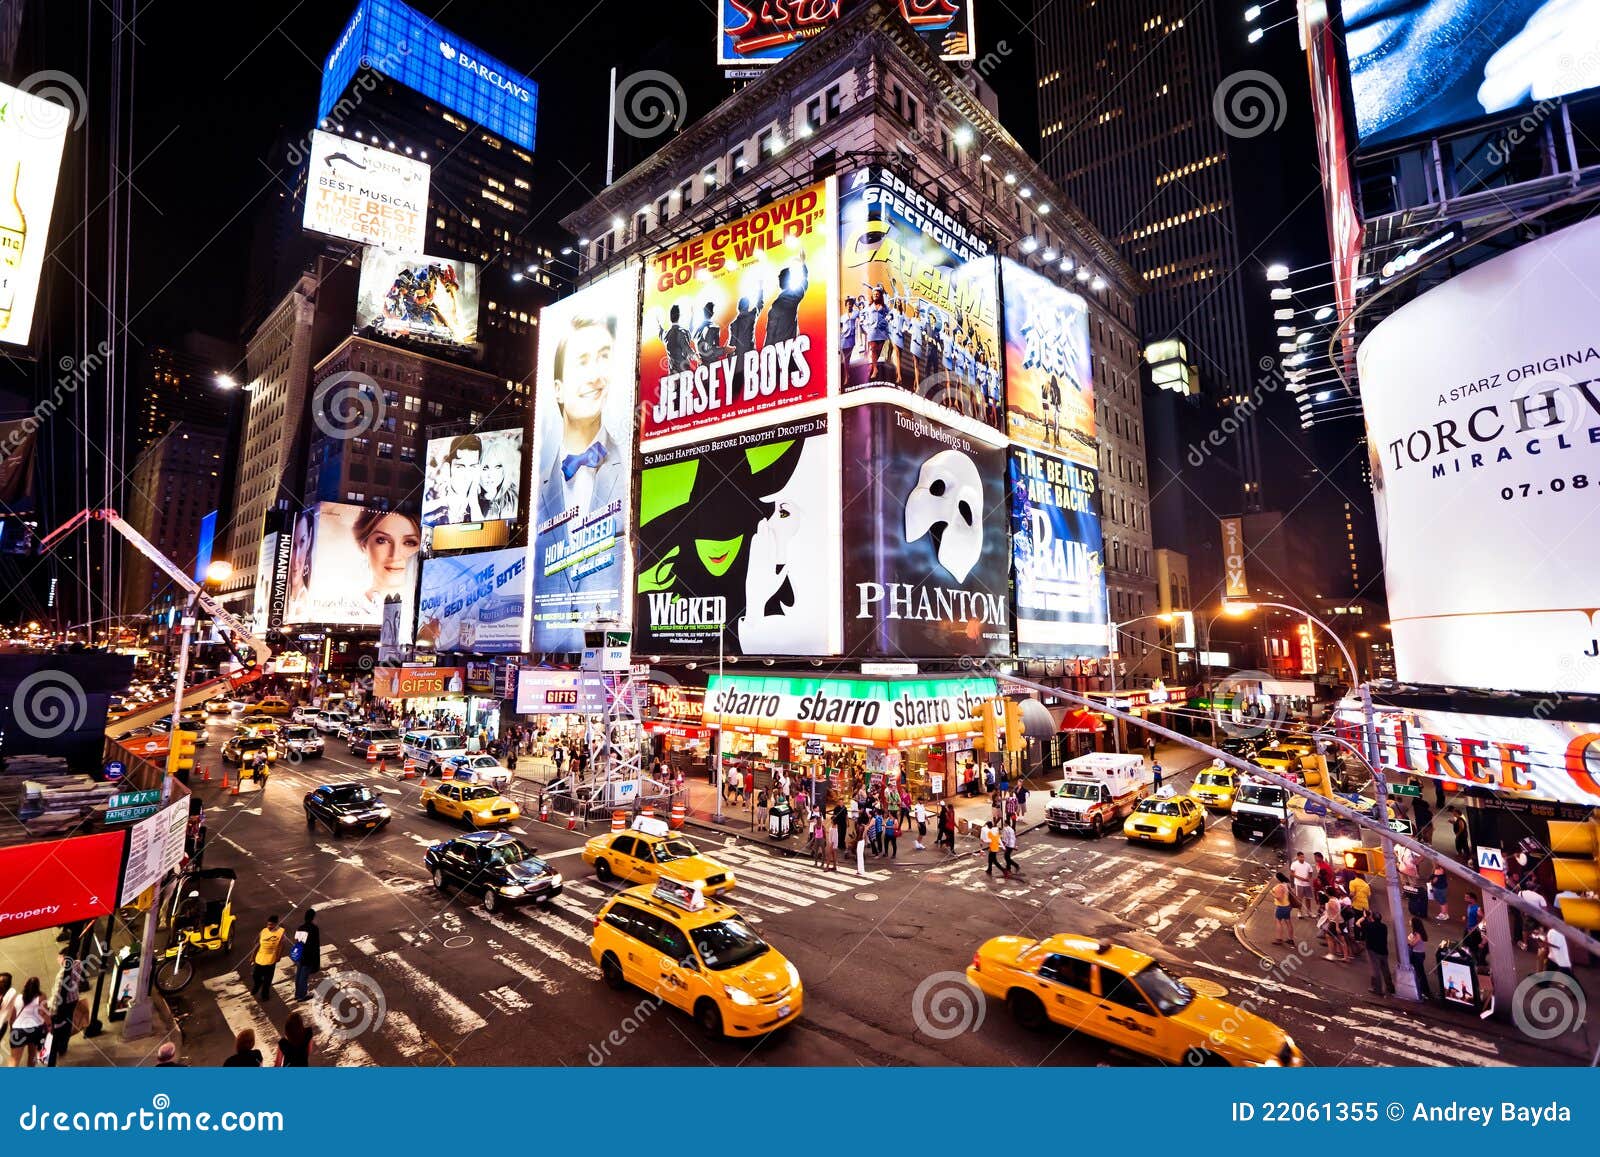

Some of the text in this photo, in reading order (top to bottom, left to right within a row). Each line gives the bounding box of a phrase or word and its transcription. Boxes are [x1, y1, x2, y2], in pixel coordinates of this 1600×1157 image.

[458, 53, 530, 103] BARCLAYS
[319, 176, 419, 212] BEST MUSICAL
[319, 188, 418, 224] THE BEST
[880, 168, 988, 255] SPECTACULAR
[711, 191, 818, 250] CROWD
[653, 334, 811, 424] JERSEY BOYS
[1438, 394, 1448, 406] A
[1450, 374, 1502, 402] STARZ
[737, 406, 755, 416] West
[777, 394, 803, 405] Street
[675, 442, 711, 459] HAPPENED
[711, 437, 738, 451] BEFORE
[738, 428, 776, 444] DOROTHY
[777, 422, 815, 437] DROPPED
[895, 411, 929, 438] Tonight
[930, 424, 961, 450] belongs
[1027, 479, 1053, 504] ARE
[1046, 456, 1095, 493] BEATLES
[544, 540, 565, 567] HOW
[571, 517, 617, 552] SUCCEED
[1031, 507, 1088, 582] RAIN
[444, 598, 463, 618] BED
[466, 581, 494, 606] BUGS
[496, 556, 526, 588] BITE!
[473, 563, 495, 584] THE
[856, 582, 1007, 626] PHANTOM
[401, 679, 443, 693] GIFTS
[472, 669, 492, 681] GIFTS
[547, 690, 577, 703] GIFTS
[669, 701, 704, 718] STEAKS
[713, 687, 781, 717] sbarro
[797, 690, 881, 726] sbarro
[894, 694, 951, 727] sbarro
[121, 795, 130, 805] W
[132, 792, 147, 803] 47
[1398, 785, 1404, 793] 7
[106, 809, 132, 818] FATHER
[0, 896, 99, 923] Property 2
